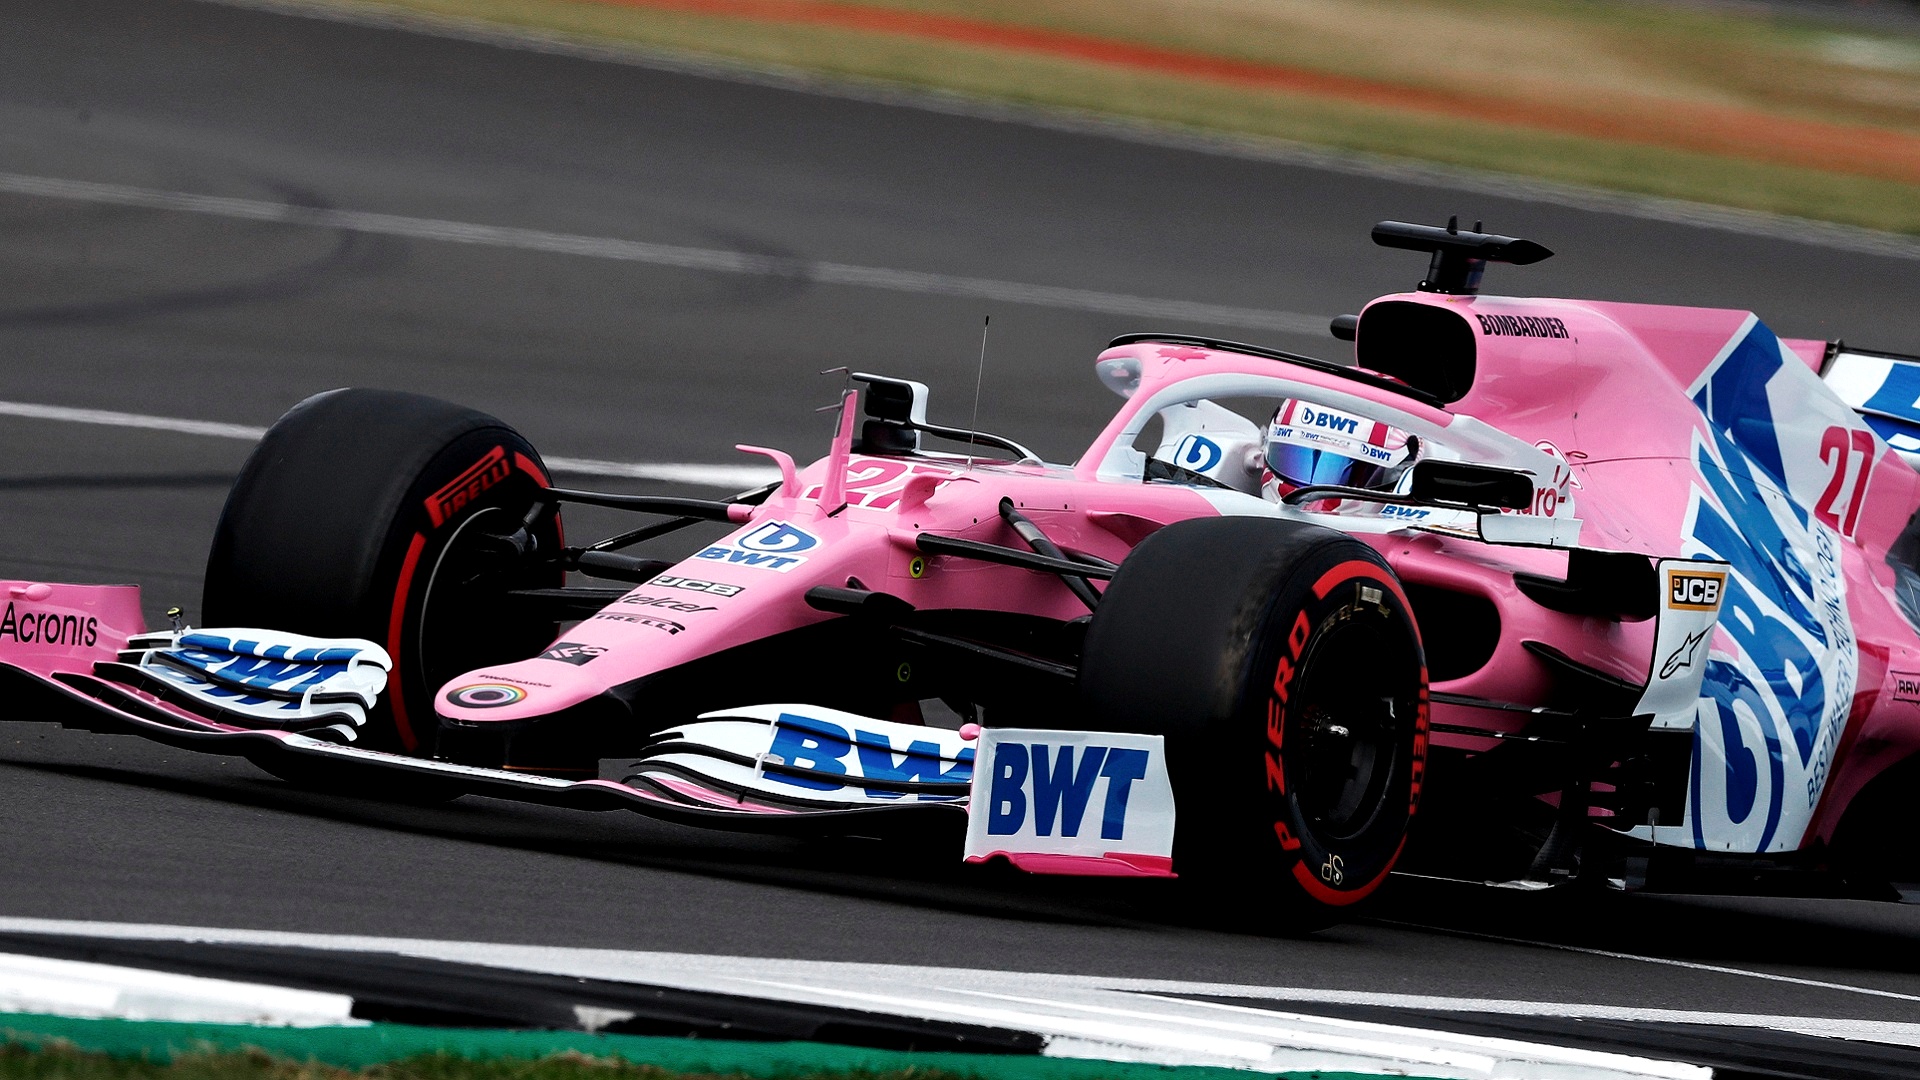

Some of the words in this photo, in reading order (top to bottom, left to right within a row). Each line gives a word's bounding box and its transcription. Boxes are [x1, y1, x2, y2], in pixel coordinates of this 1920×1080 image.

[1475, 314, 1570, 339] BOMBARDIER
[1277, 428, 1293, 438] BWT
[1316, 412, 1359, 435] BWT
[1369, 448, 1392, 462] BWT
[424, 445, 511, 529] PIRELLI
[806, 459, 953, 509] 27
[1814, 426, 1875, 538] 27
[1381, 505, 1431, 519] BWT
[695, 547, 800, 569] BWT
[651, 576, 742, 597] JCB
[1673, 578, 1720, 604] JCB
[0, 601, 98, 647] Acronis
[1265, 609, 1311, 796] ZERO
[761, 712, 977, 802] BW
[1807, 735, 1831, 810] BEST
[987, 742, 1150, 840] BWT
[1274, 821, 1301, 851] P
